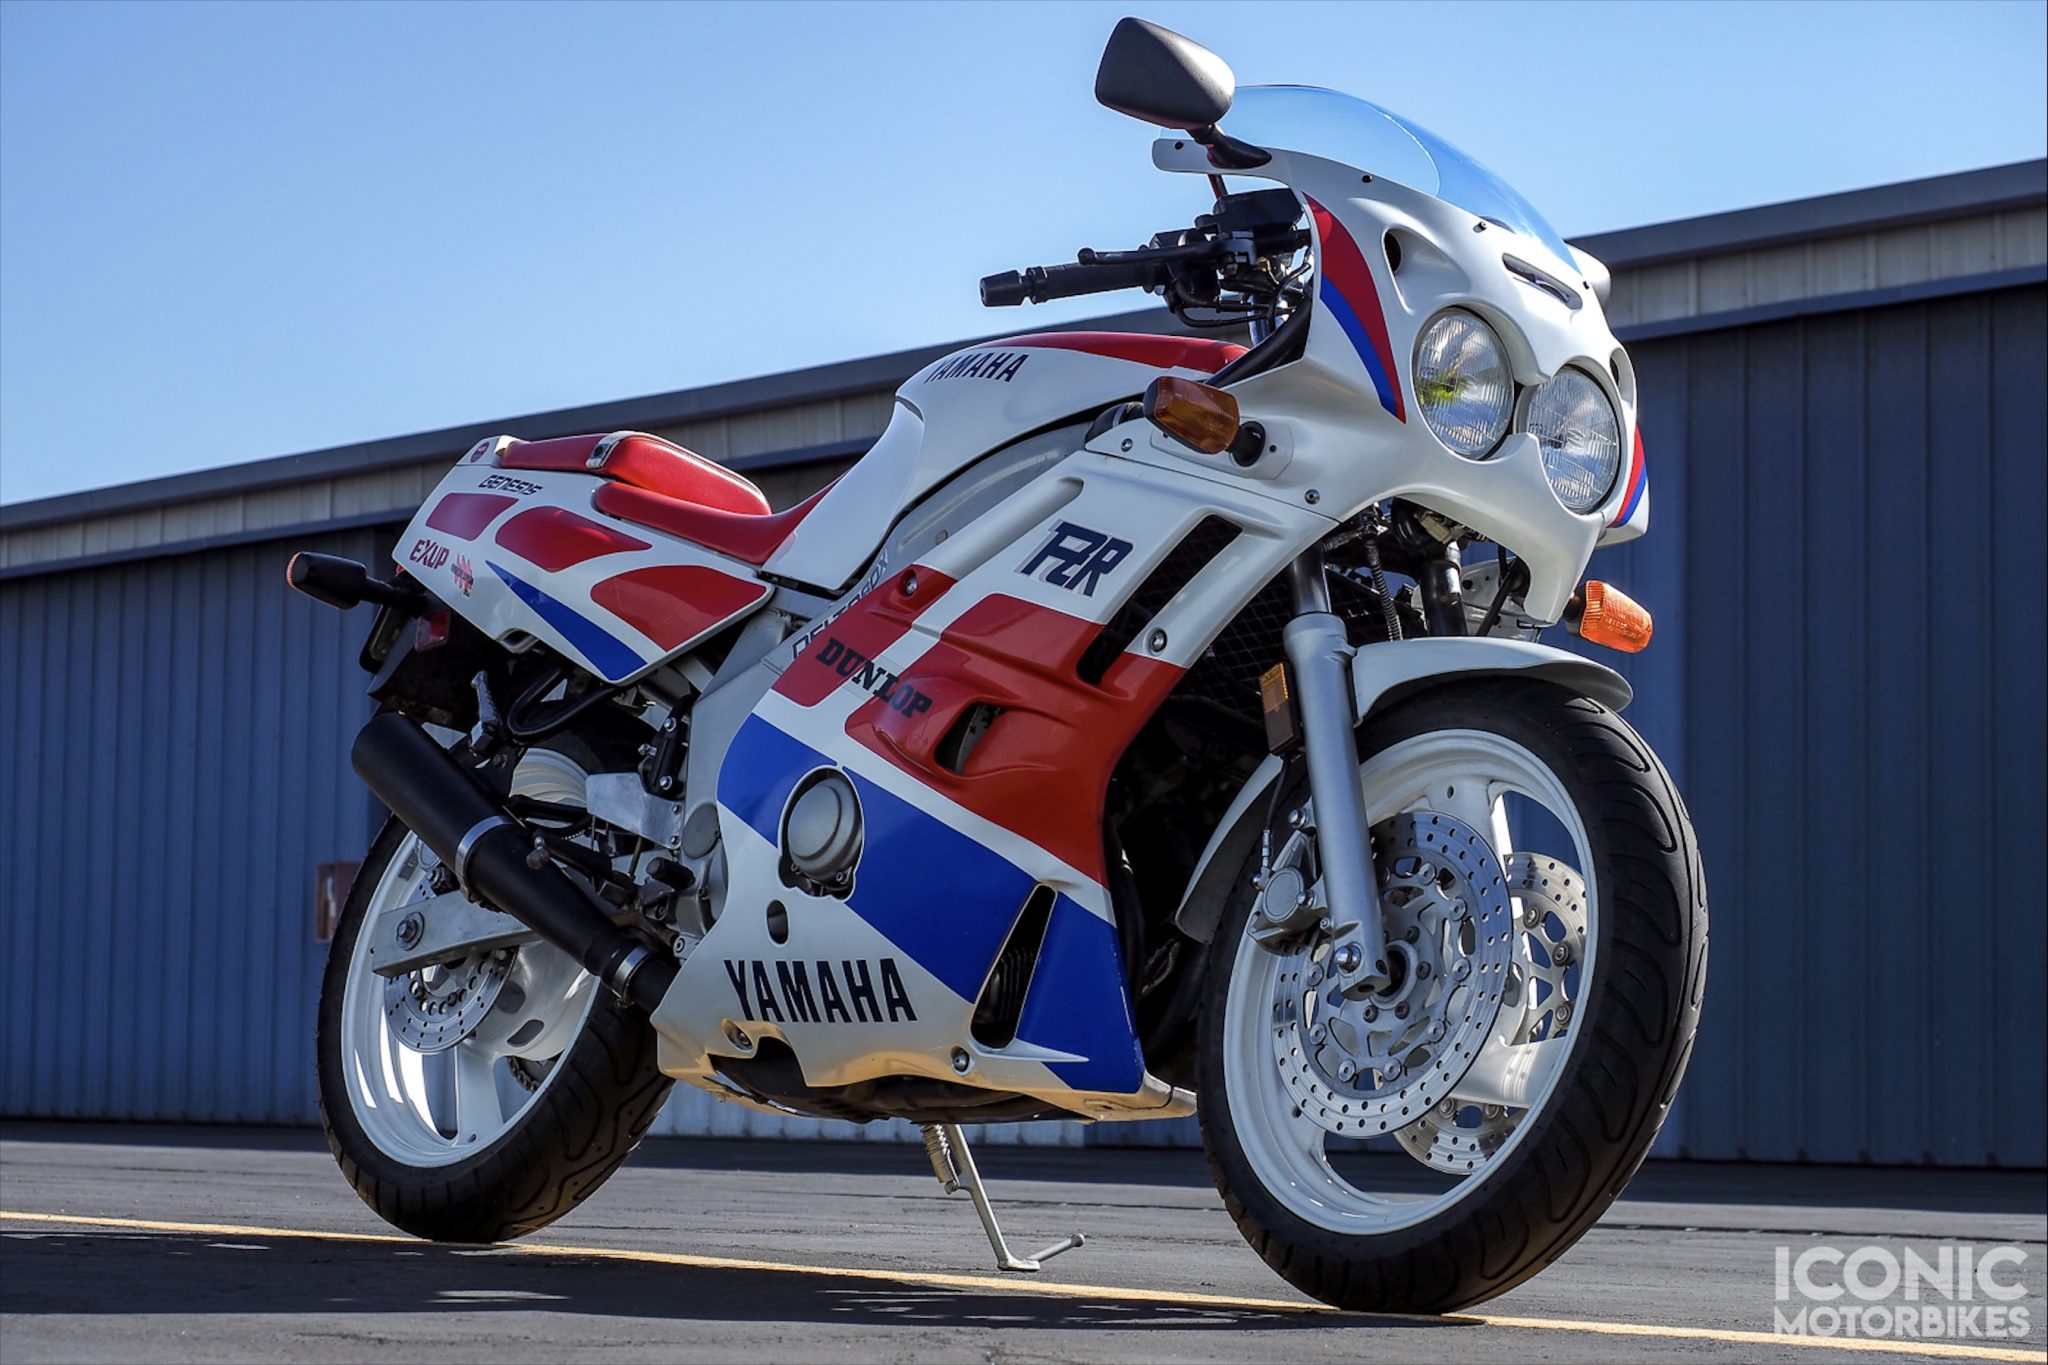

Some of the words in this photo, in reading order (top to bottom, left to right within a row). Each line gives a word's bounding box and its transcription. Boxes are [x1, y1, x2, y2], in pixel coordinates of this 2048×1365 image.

[478, 474, 543, 496] GENESIS
[409, 539, 450, 570] EXUP
[1014, 519, 1135, 599] FZR
[816, 637, 933, 719] DUNLOP
[724, 957, 917, 1023] YAMAHA
